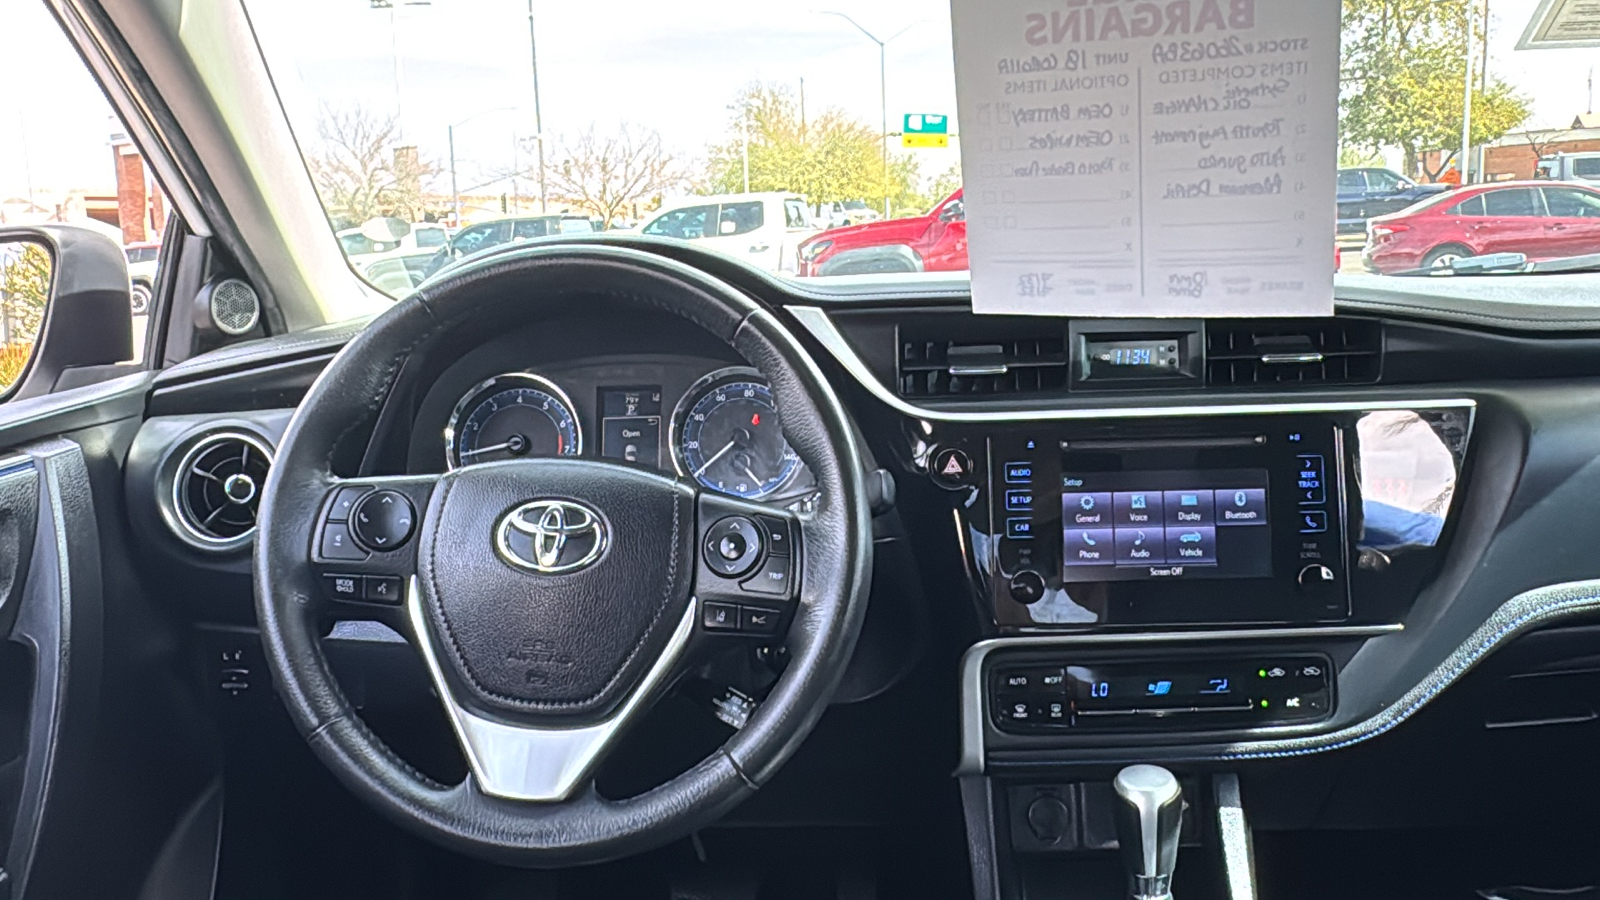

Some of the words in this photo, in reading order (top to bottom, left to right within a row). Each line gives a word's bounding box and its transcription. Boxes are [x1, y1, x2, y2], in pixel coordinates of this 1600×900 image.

[715, 394, 726, 402] 60
[744, 389, 755, 398] 80
[516, 396, 523, 404] 4
[491, 403, 498, 412] 3
[542, 402, 549, 411] 5
[693, 413, 705, 422] 40
[472, 422, 479, 431] 2
[560, 420, 566, 428] 6
[622, 429, 641, 438] Open
[688, 441, 699, 449] 20
[564, 446, 570, 454] 7
[1010, 469, 1032, 477] AUDIO
[1300, 471, 1317, 479] SEEK
[1063, 477, 1083, 487] Setup
[1298, 480, 1320, 488] TRACK
[1010, 496, 1033, 504] SETUP
[1075, 513, 1100, 523] General
[1129, 512, 1149, 522] Voice
[1177, 511, 1202, 521] Display
[1224, 510, 1258, 519] Bluetooth
[1014, 523, 1030, 532] CAR
[1078, 549, 1100, 559] Phone
[1130, 548, 1151, 558] Audio
[1179, 548, 1203, 557] Vehicle
[1149, 566, 1171, 576] Screen
[1171, 566, 1184, 576] Off
[768, 572, 784, 580] TRIP
[1009, 677, 1028, 685] AUTO
[1050, 676, 1063, 684] OFF
